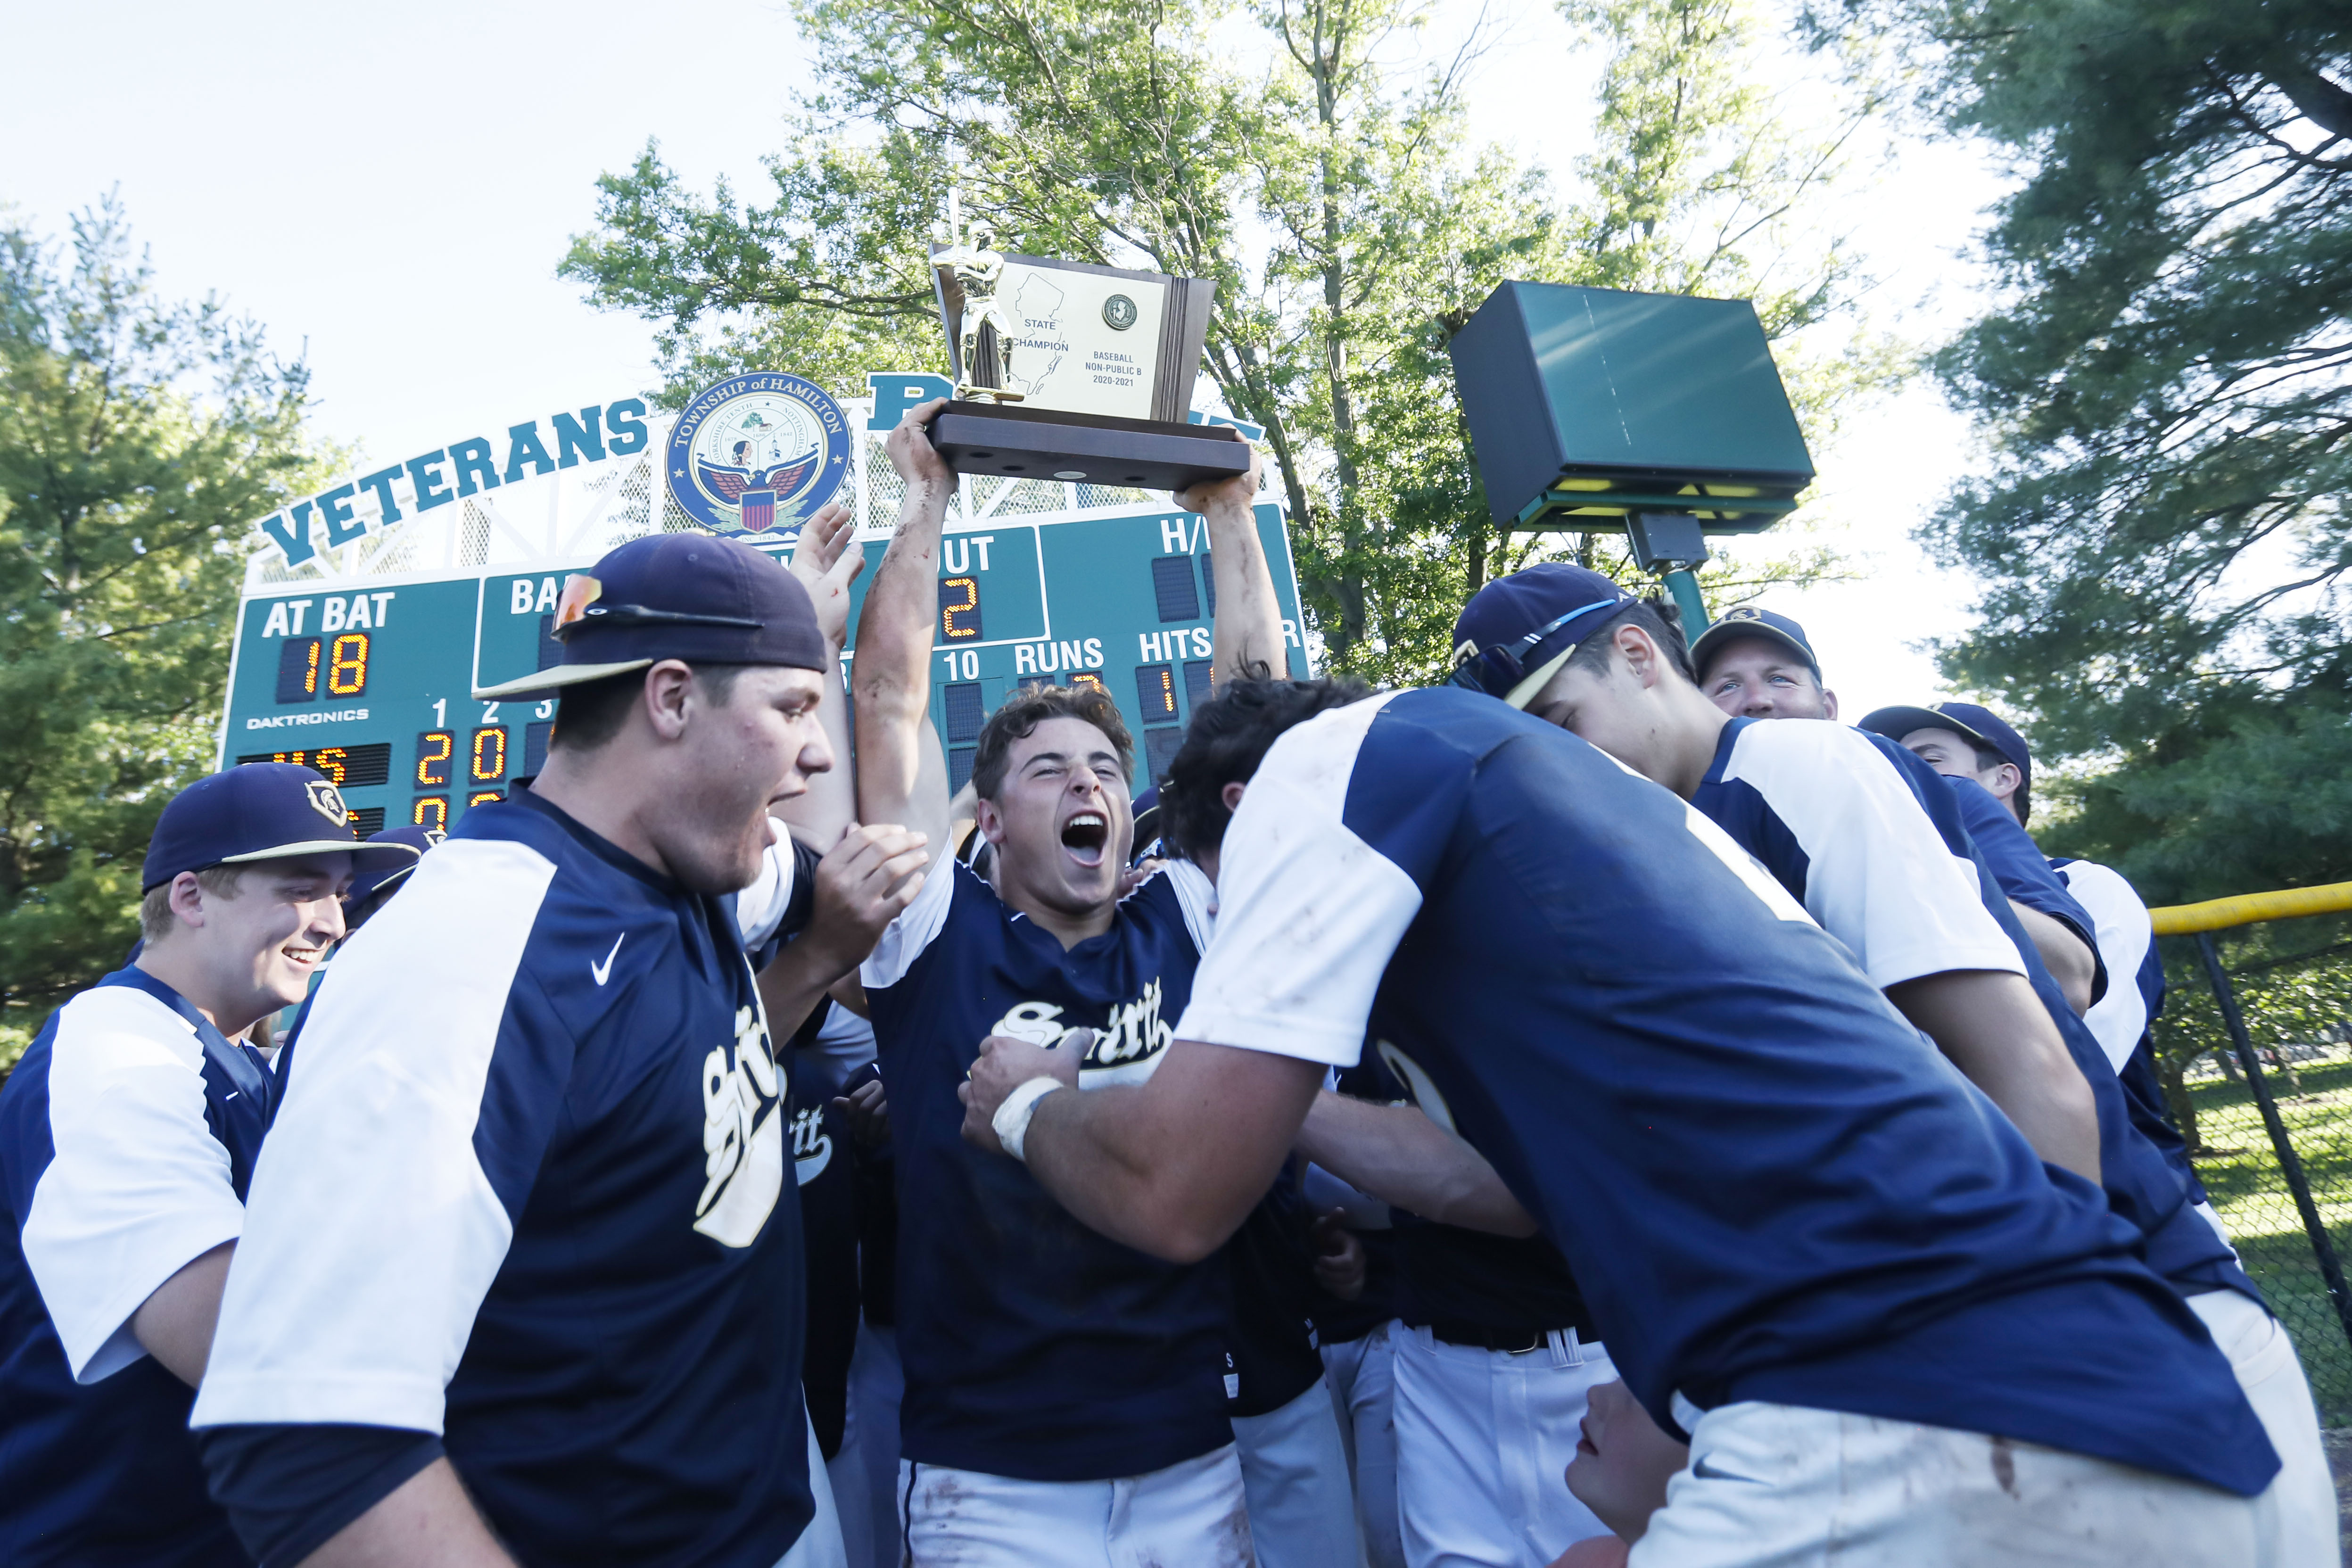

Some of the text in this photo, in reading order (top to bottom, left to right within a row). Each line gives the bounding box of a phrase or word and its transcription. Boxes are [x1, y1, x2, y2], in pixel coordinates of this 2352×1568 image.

[1024, 319, 1056, 330] STATE
[1013, 338, 1069, 352] CHAMPION
[1094, 351, 1134, 363] BASEBALL
[1086, 362, 1142, 376] NON-PUBLIC B
[1093, 375, 1134, 387] 2020-2021
[674, 380, 746, 447] TOWNSHIP
[751, 377, 767, 389] of
[769, 378, 842, 435] HAMILTON
[726, 403, 753, 420] TENTH
[783, 407, 805, 456] NOTTINGHAM
[261, 398, 648, 567] VETERANS
[937, 536, 995, 574] UT
[262, 591, 396, 638] AT BAT
[943, 577, 977, 637] 2
[304, 634, 369, 694] 18
[943, 650, 979, 681] 10
[1015, 627, 1213, 674] RUNS HITS
[247, 709, 370, 730] DAKTRONICS
[432, 698, 553, 728] 1 2 3
[418, 728, 505, 784] 2 0
